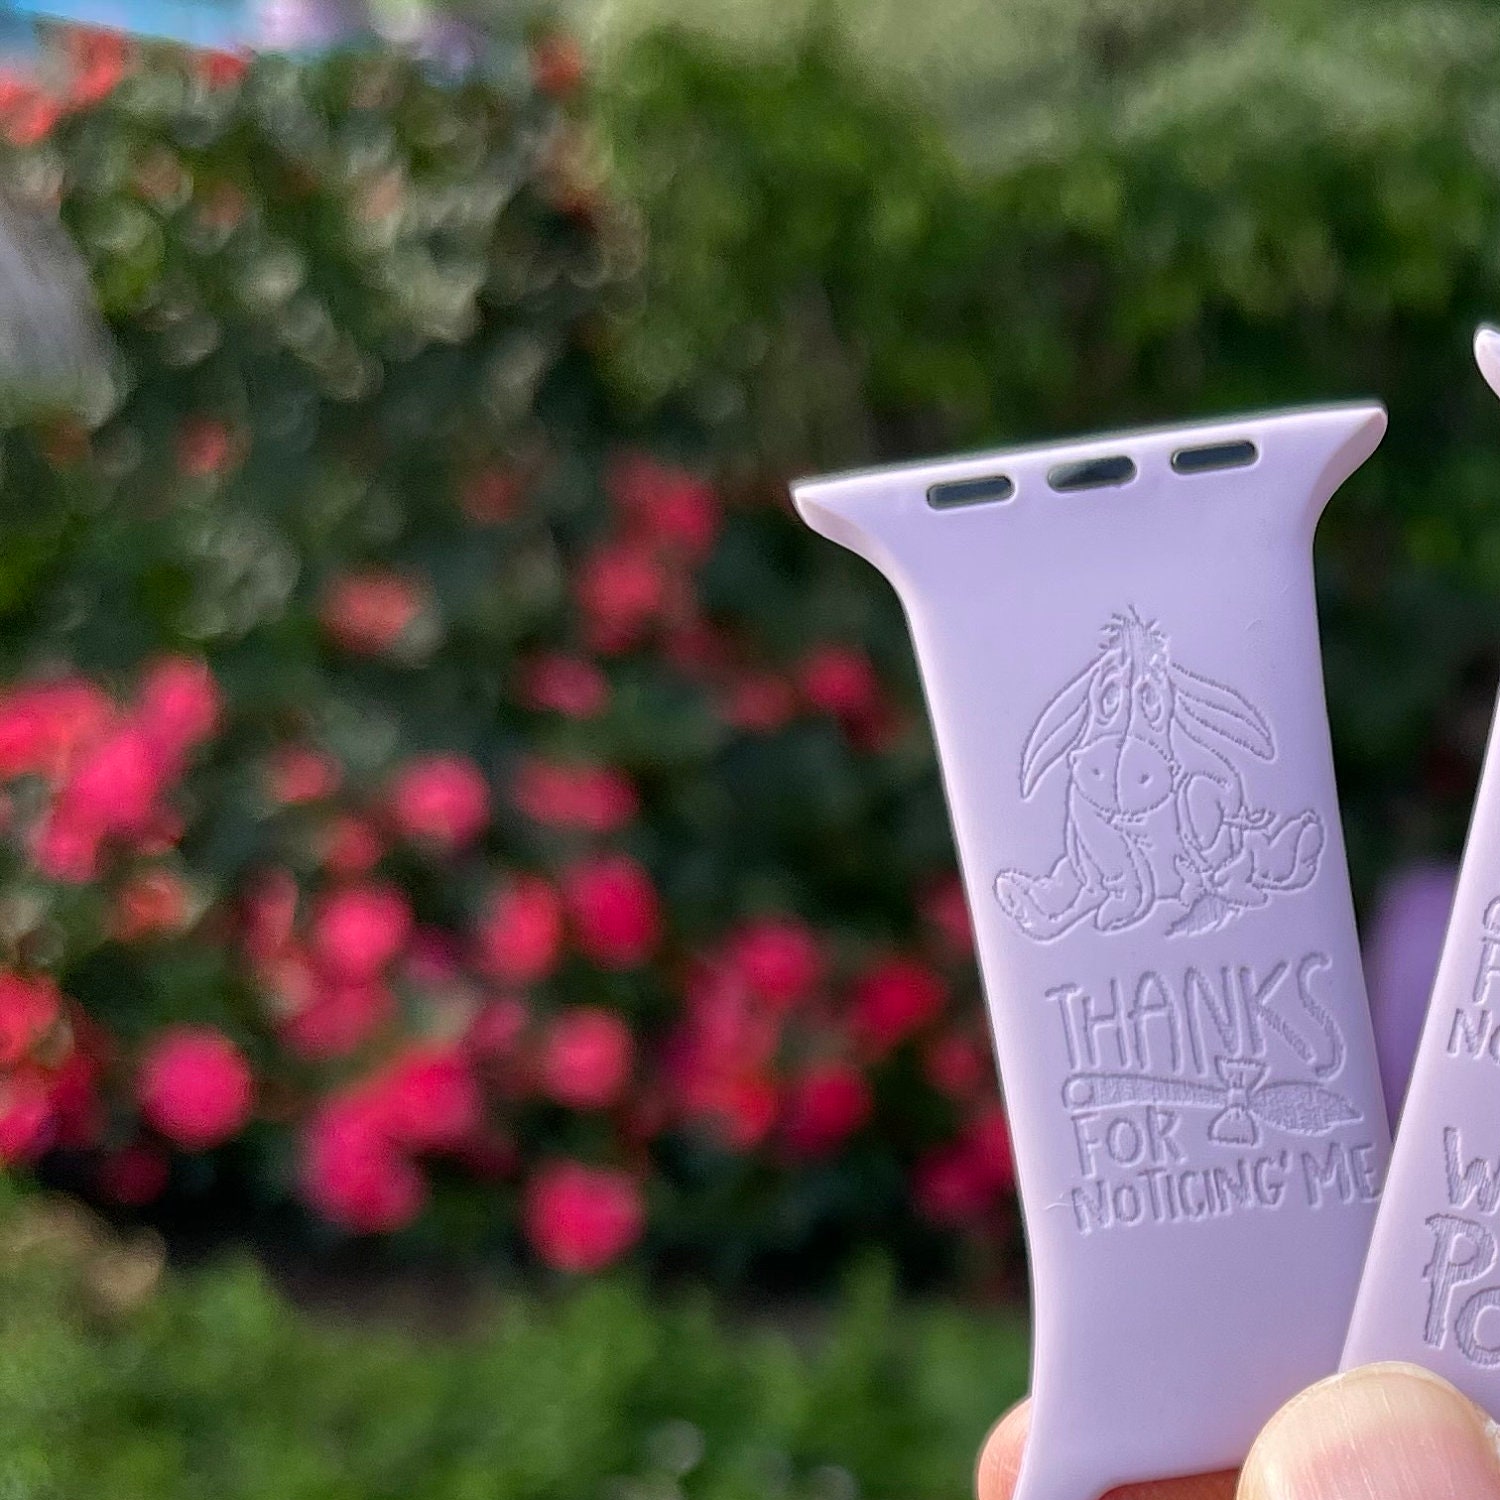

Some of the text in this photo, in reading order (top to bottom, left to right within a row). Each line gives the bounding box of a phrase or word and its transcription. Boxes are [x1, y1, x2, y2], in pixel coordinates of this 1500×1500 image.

[1045, 952, 1346, 1081] THANKS
[1070, 1106, 1187, 1179] FOR
[1302, 1142, 1382, 1210] ME
